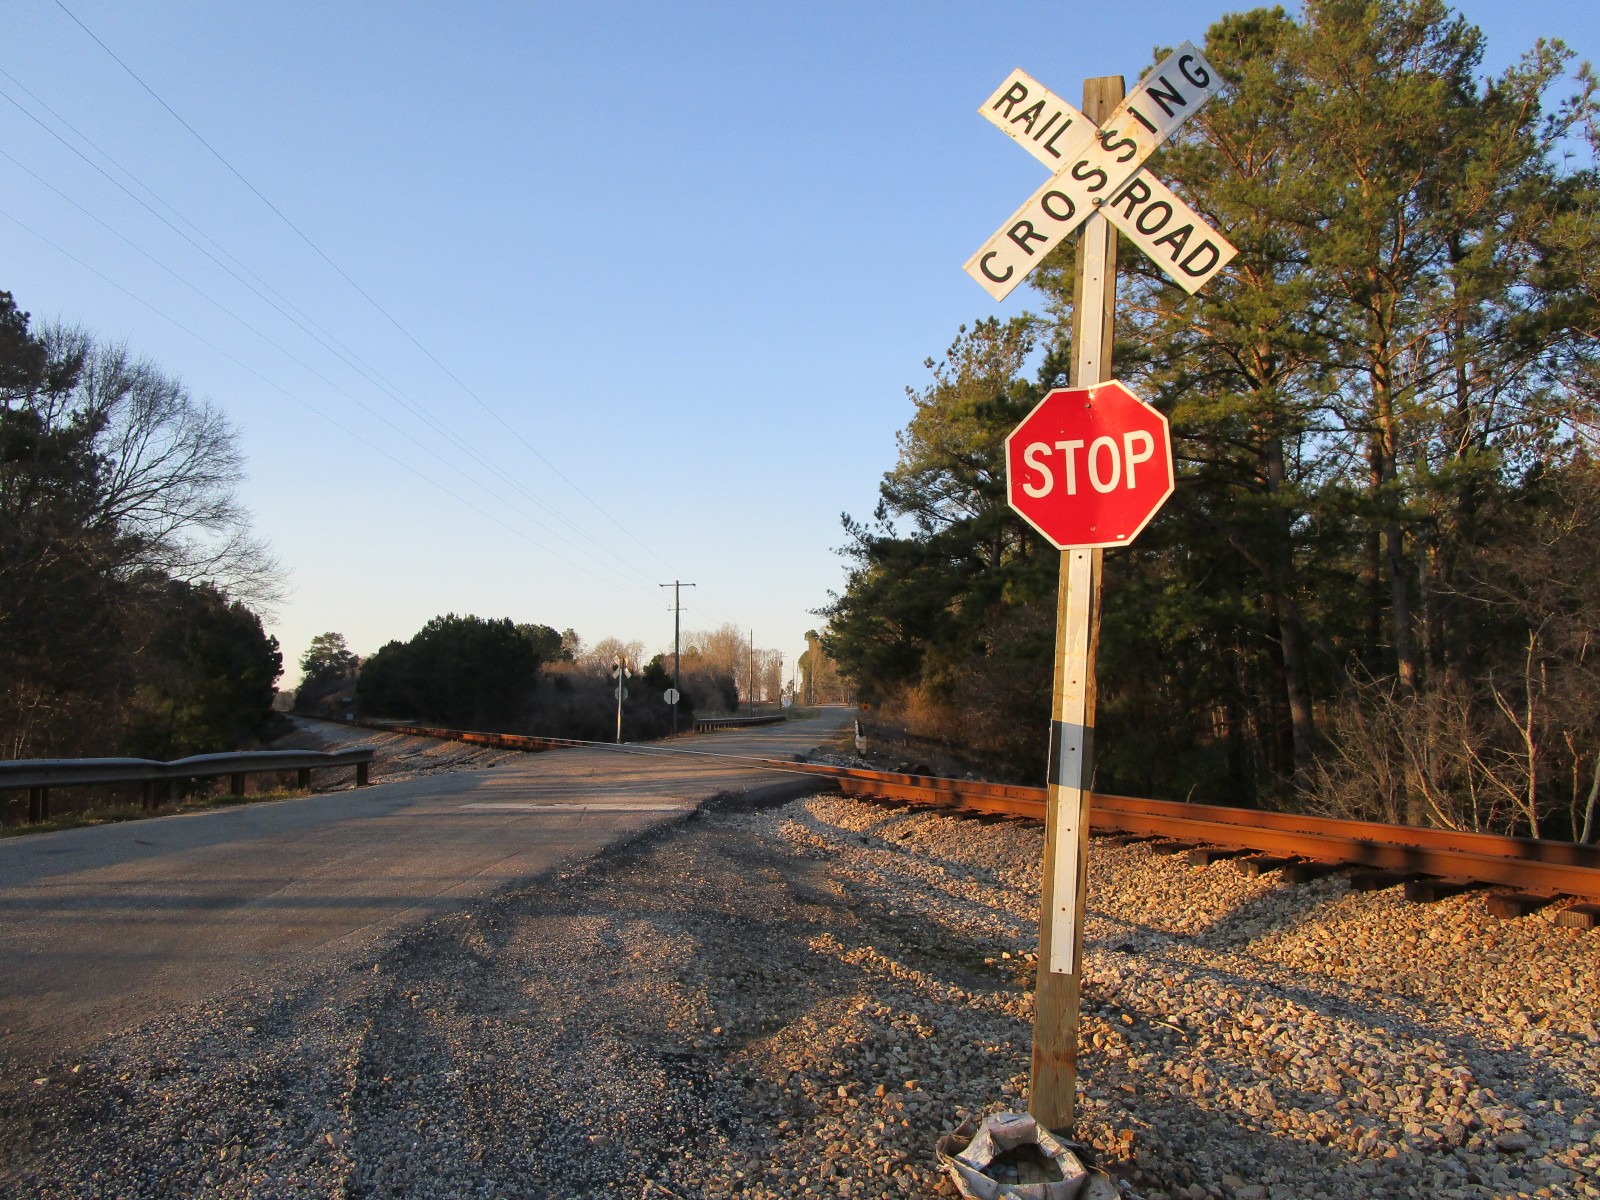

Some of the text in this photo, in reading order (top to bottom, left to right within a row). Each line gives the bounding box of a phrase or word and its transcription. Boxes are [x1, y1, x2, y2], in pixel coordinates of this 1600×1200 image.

[979, 54, 1210, 284] CROSSING
[992, 81, 1220, 278] RAIL ROAD
[1022, 429, 1155, 499] STOP
